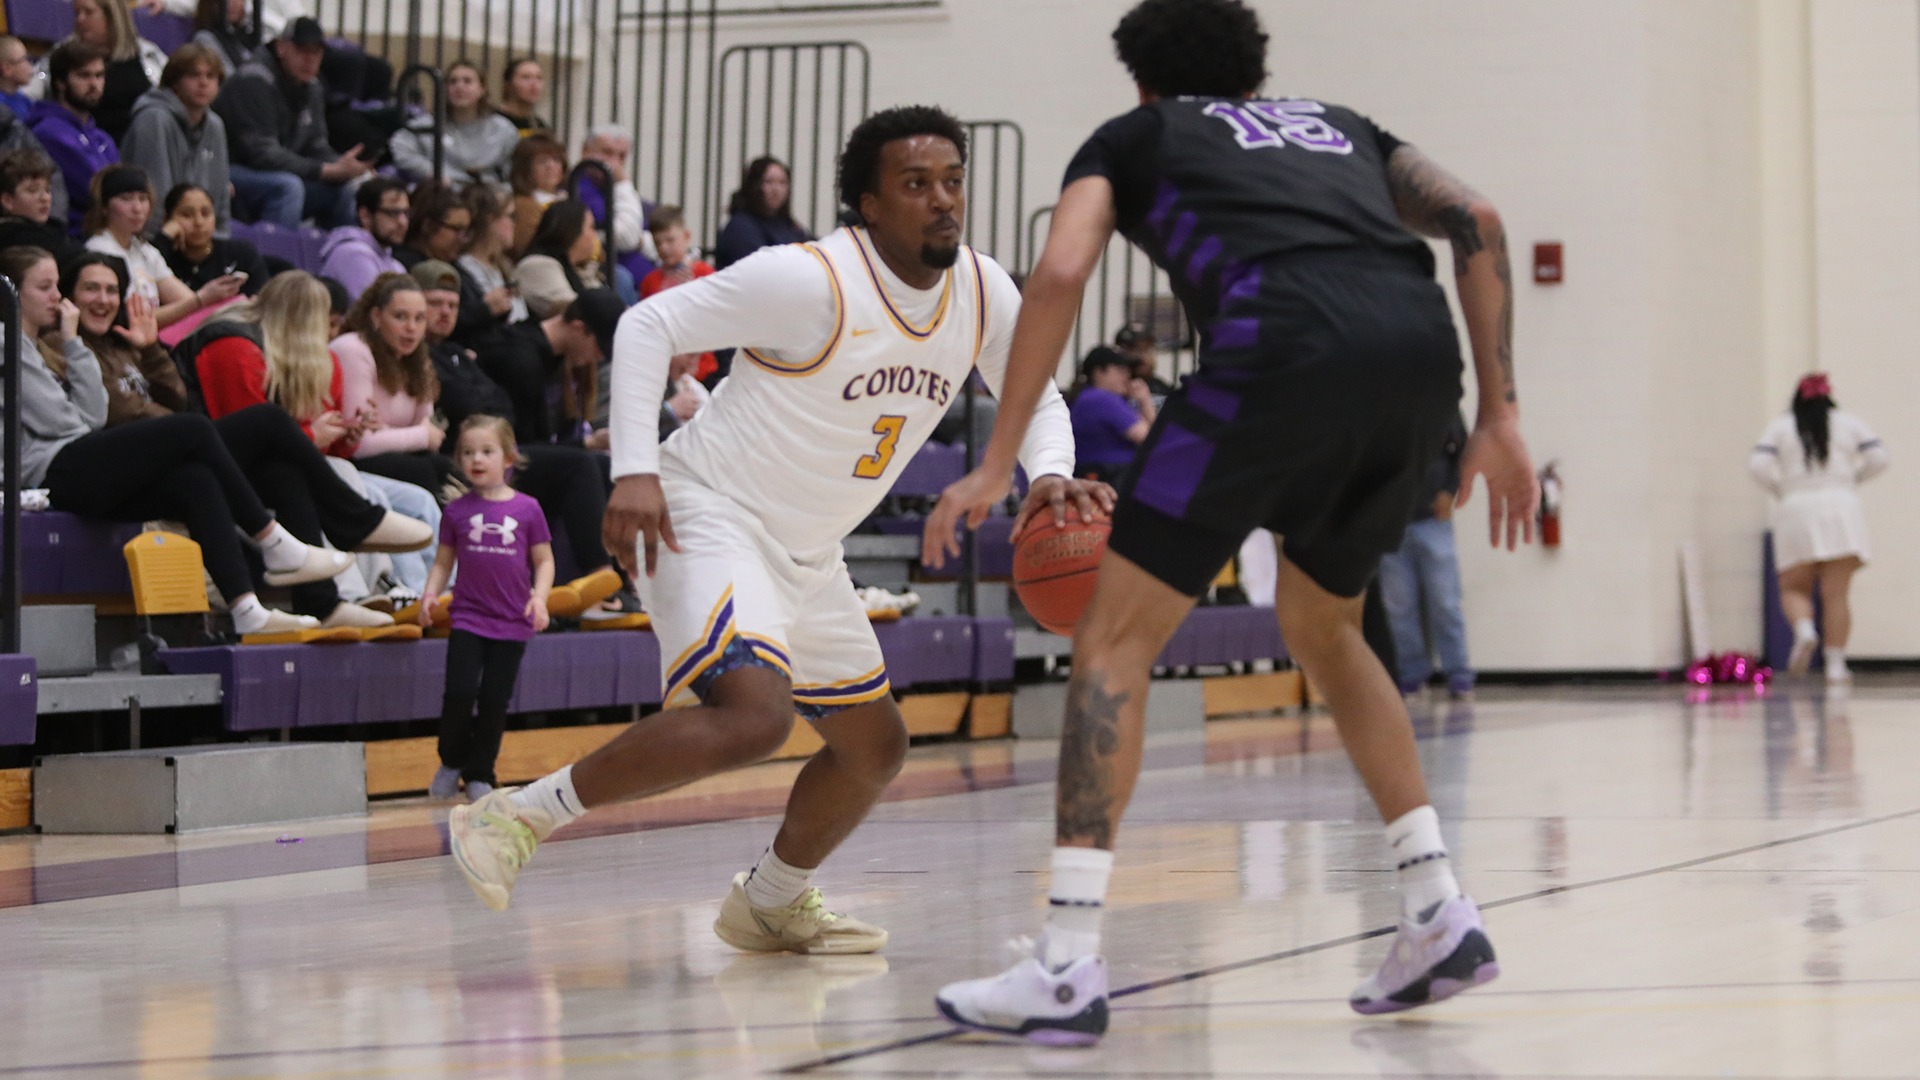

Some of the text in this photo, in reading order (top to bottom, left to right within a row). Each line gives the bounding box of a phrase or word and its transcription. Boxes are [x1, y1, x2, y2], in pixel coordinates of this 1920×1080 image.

[1202, 101, 1353, 154] 15
[842, 365, 951, 406] COYOTES
[852, 414, 907, 479] 3
